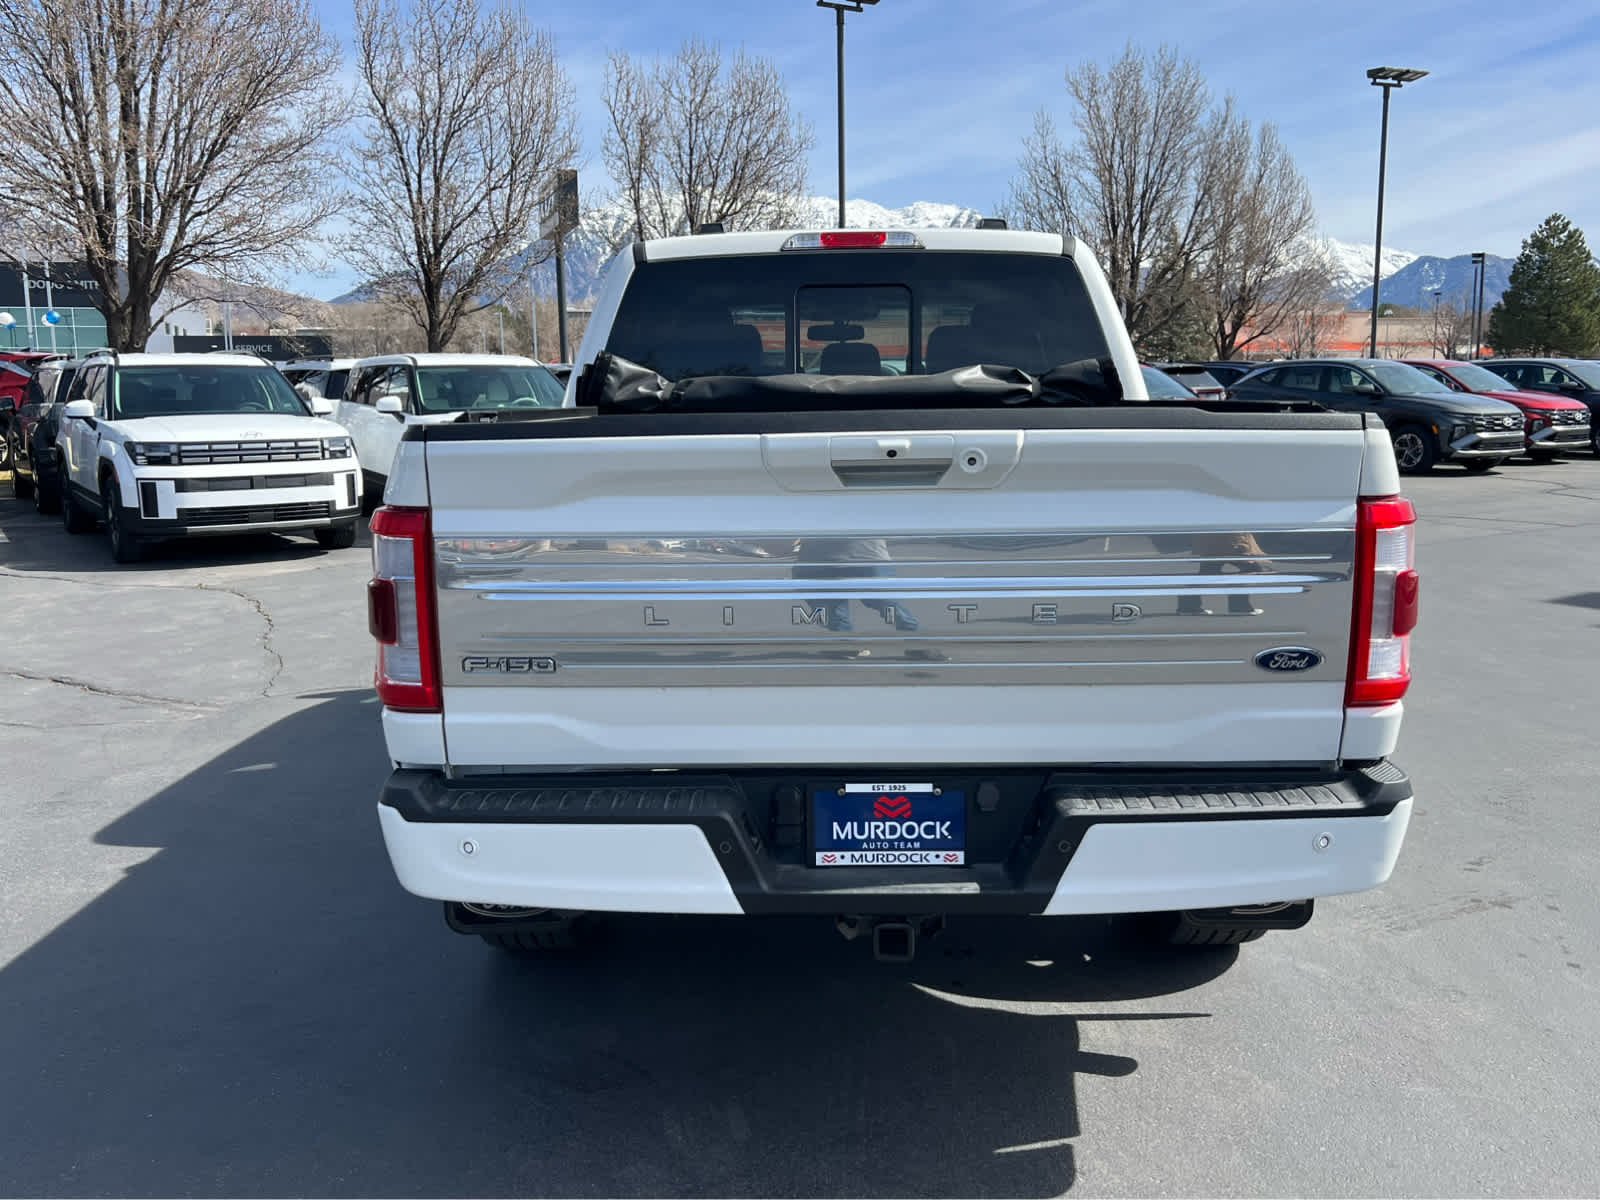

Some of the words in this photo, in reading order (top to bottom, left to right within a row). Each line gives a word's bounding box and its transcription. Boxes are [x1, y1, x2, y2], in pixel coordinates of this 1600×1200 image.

[235, 344, 272, 353] SERVICE
[644, 604, 1142, 626] LIMITED
[462, 656, 556, 673] F-150
[1269, 652, 1309, 669] Ford
[832, 821, 952, 840] MURDOCK
[850, 852, 930, 863] MURDOCK
